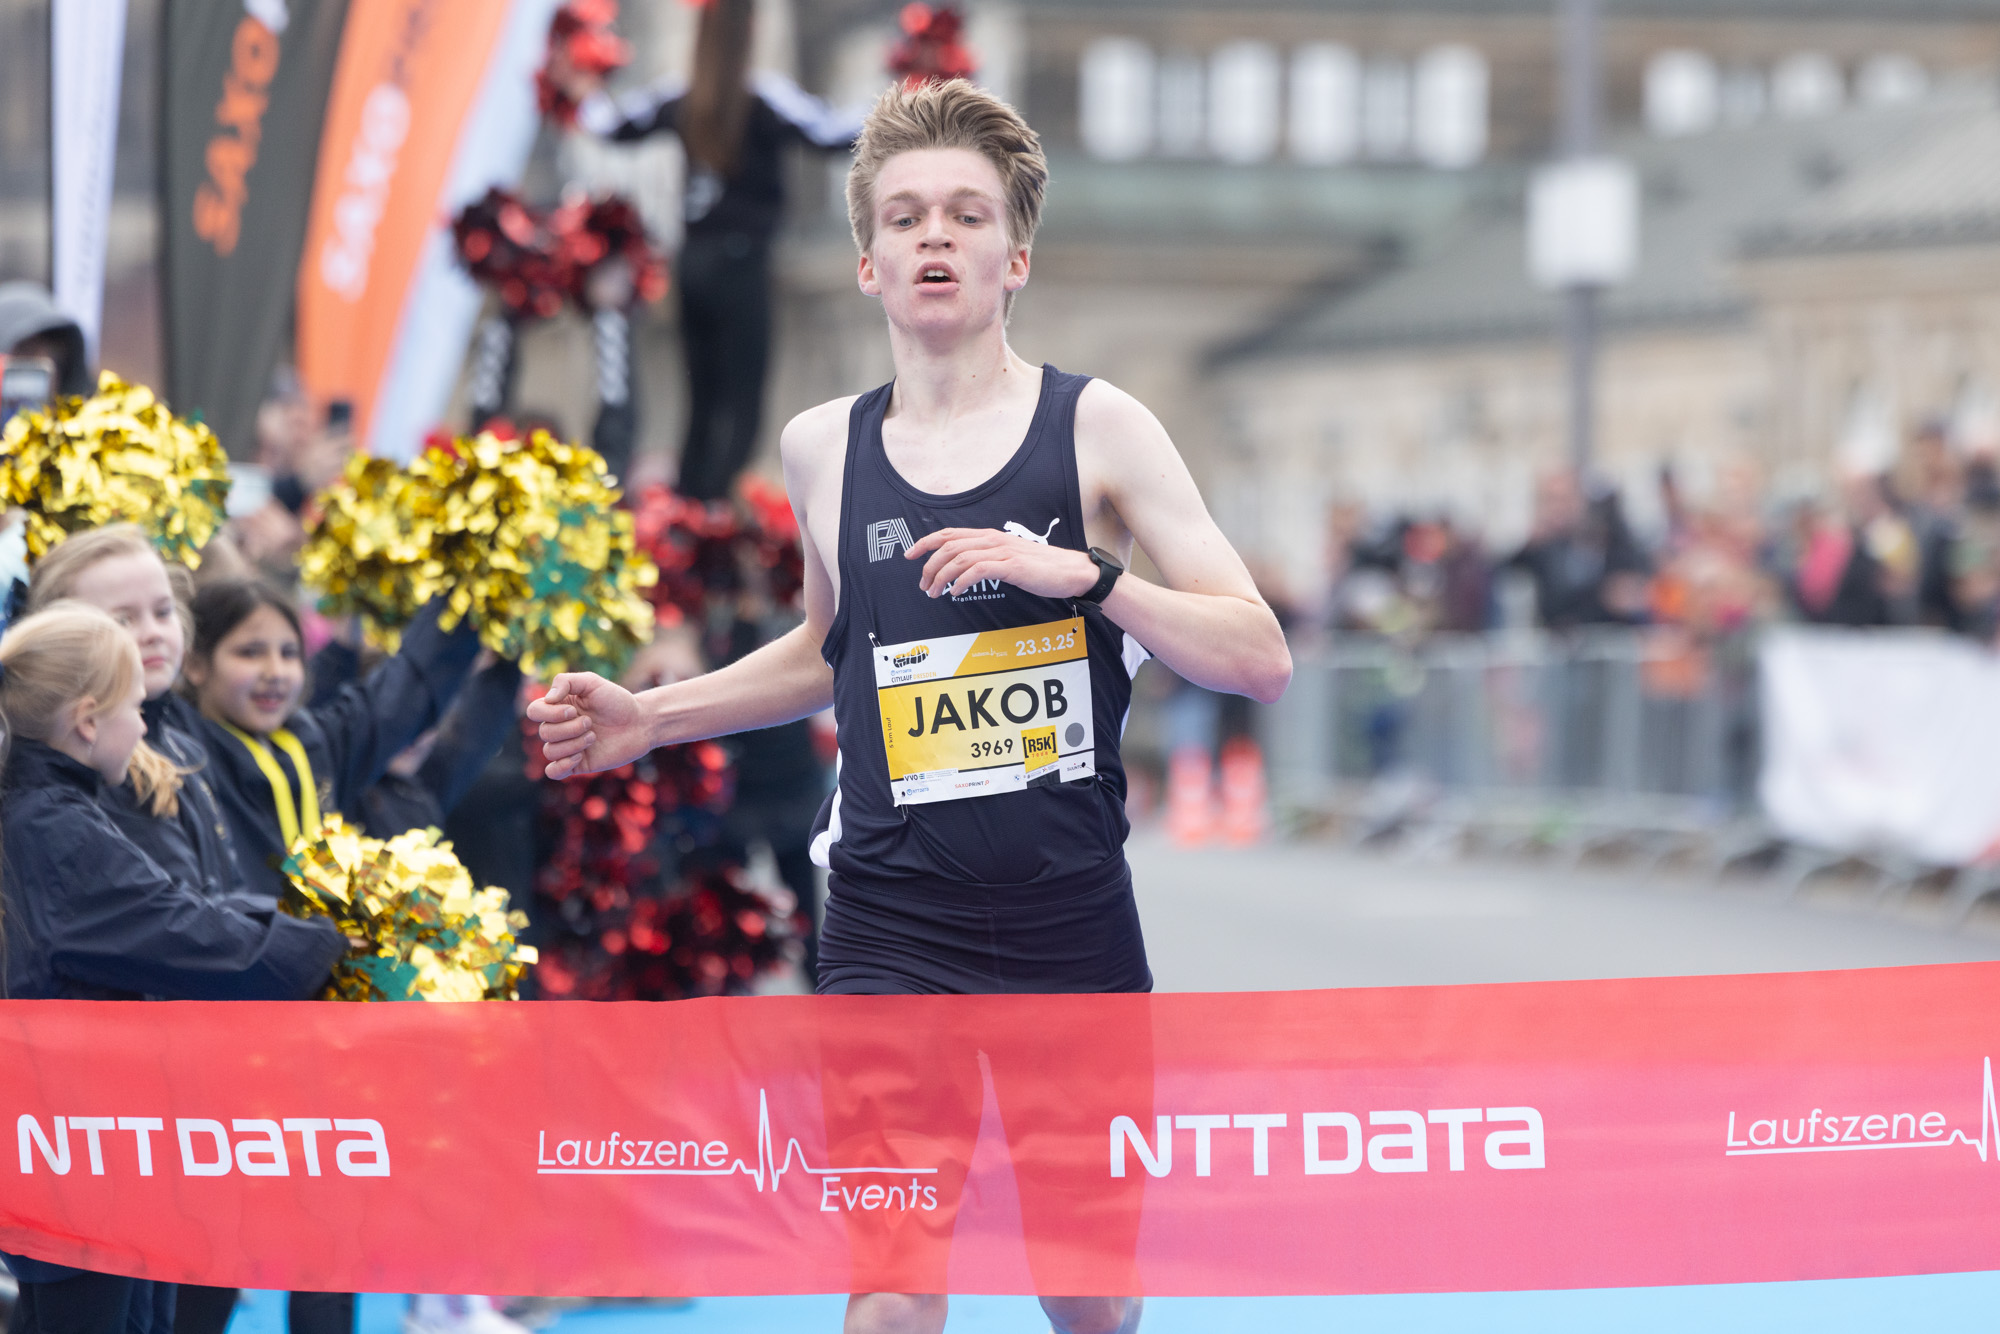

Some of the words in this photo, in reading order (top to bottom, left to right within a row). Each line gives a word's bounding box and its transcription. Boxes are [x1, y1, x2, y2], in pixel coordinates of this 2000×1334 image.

[193, 15, 281, 257] SAXO
[951, 593, 1006, 602] Krankenkasse
[1015, 632, 1075, 656] 23.3.25
[891, 674, 912, 683] CITYLAUF
[913, 671, 937, 680] DRESDEN
[908, 679, 1068, 737] JAKOB
[970, 738, 1014, 758] 3969
[904, 774, 918, 782] VVO
[954, 780, 984, 789] SAXOPRINT
[16, 1114, 164, 1176] NTT
[1726, 1107, 1946, 1147] Laufszene
[537, 1130, 729, 1166] Laufszene
[1109, 1113, 1288, 1178] NTT
[819, 1176, 938, 1212] Events
